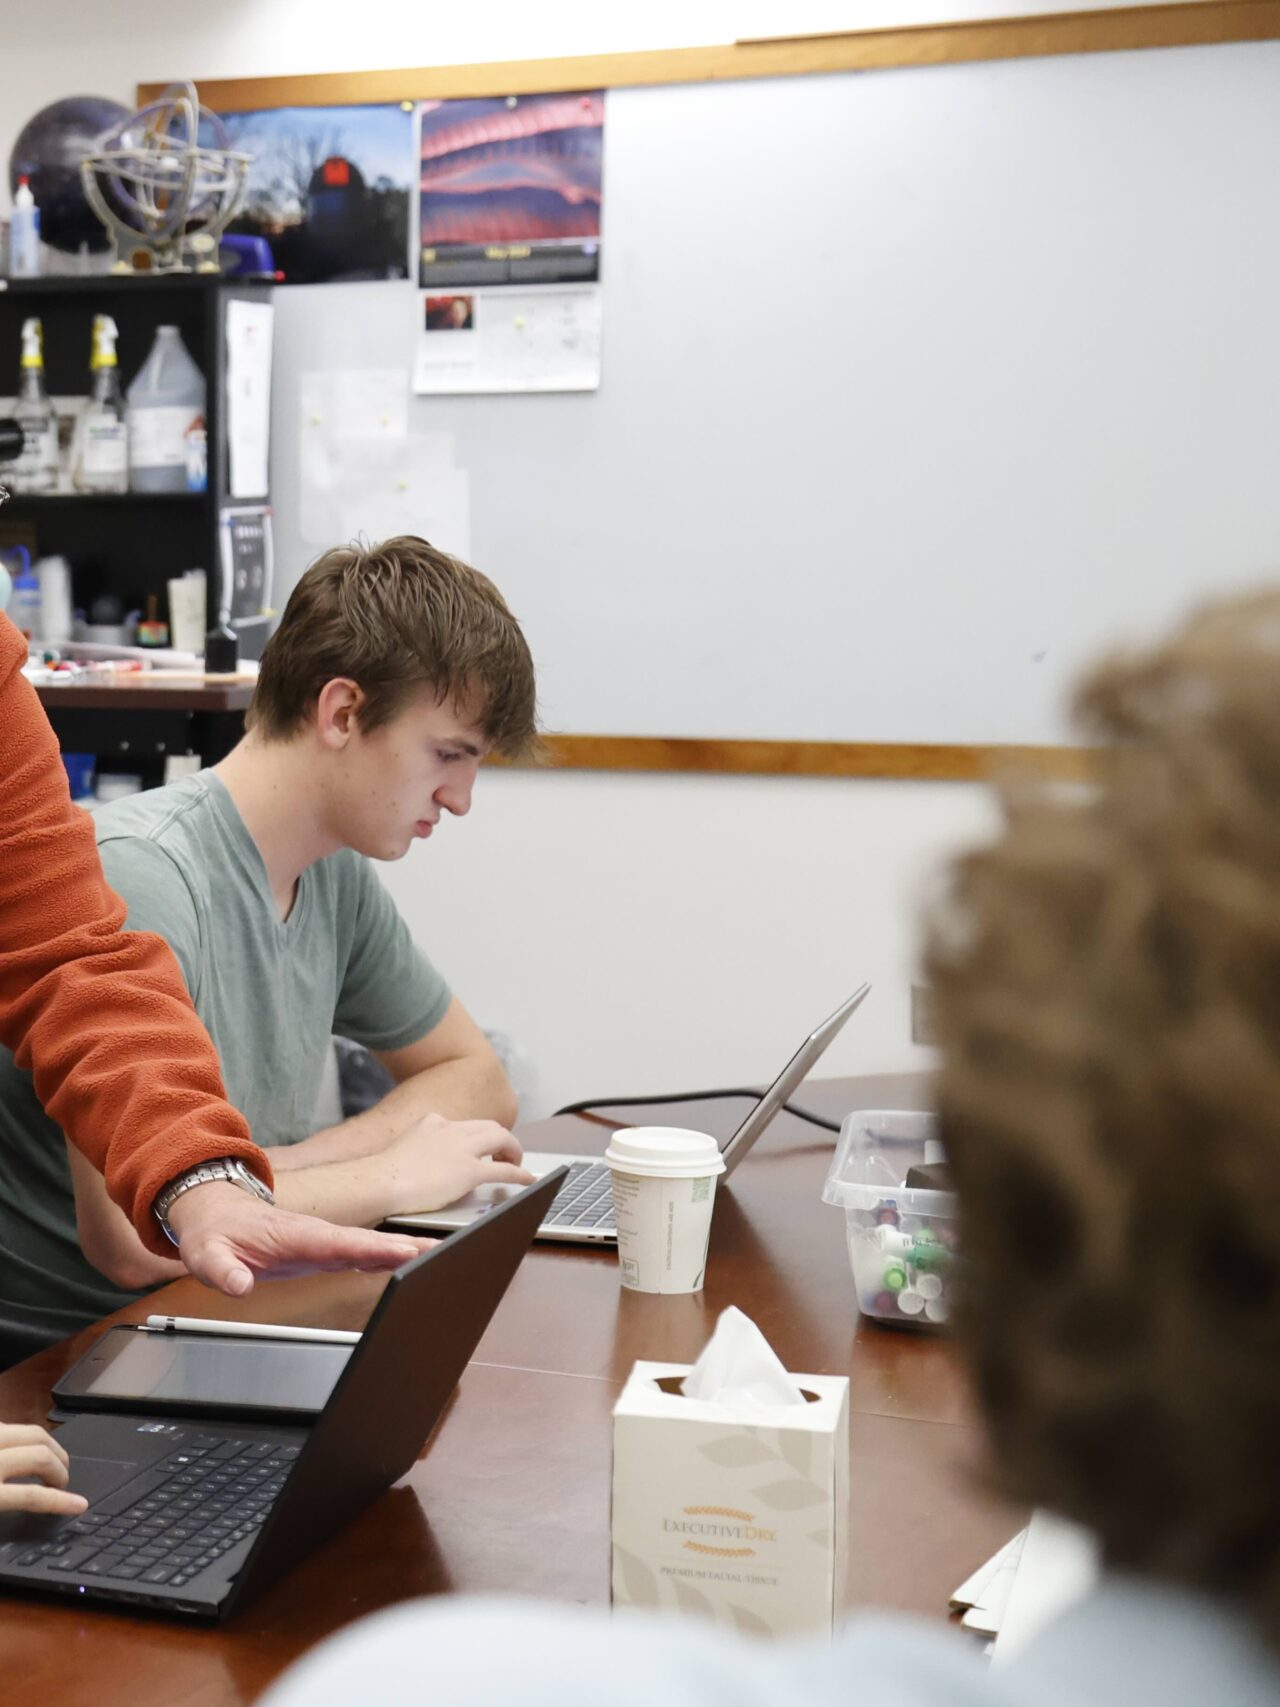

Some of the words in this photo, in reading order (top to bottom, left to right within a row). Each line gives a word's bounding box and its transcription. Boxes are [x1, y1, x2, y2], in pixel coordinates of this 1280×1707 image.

[660, 1566, 706, 1580] PREMIUM
[708, 1571, 742, 1583] FACIAL
[745, 1574, 778, 1586] TISSUE
